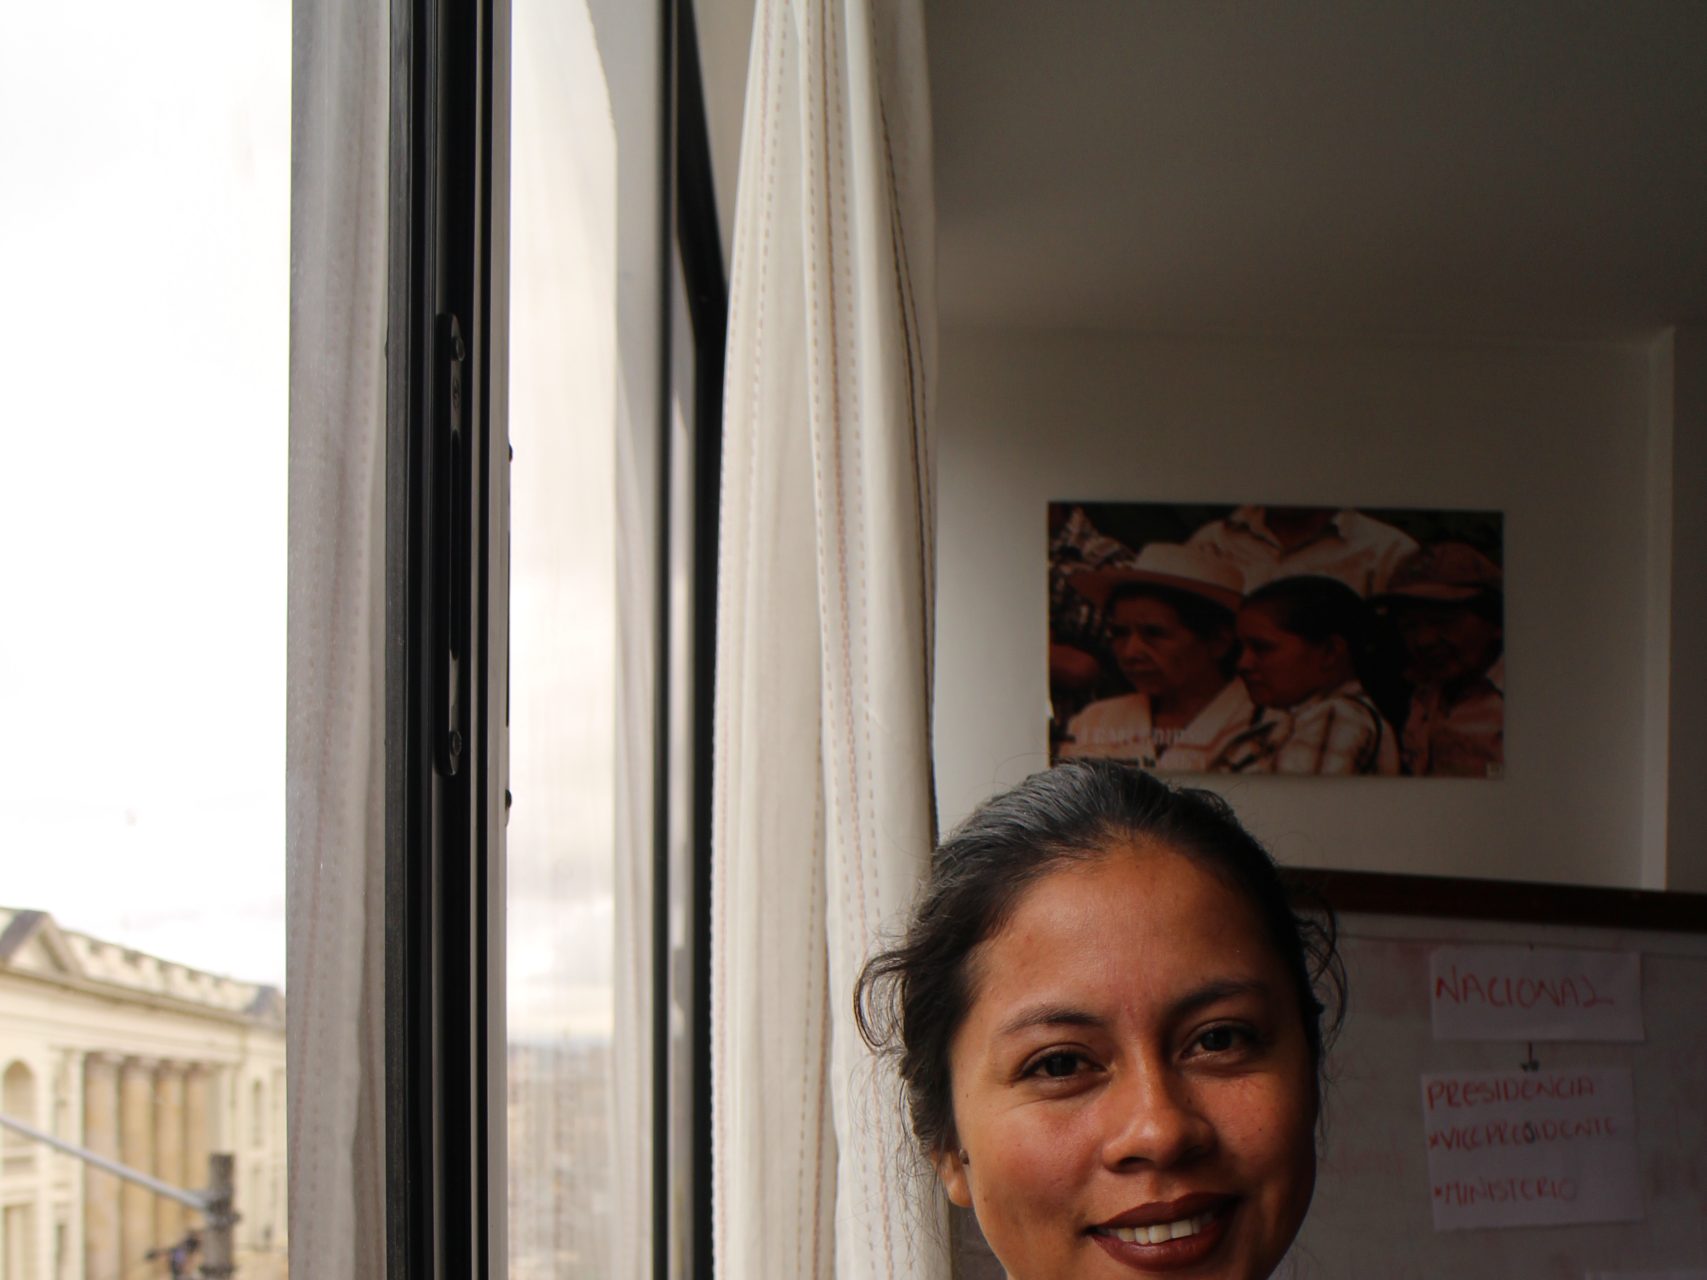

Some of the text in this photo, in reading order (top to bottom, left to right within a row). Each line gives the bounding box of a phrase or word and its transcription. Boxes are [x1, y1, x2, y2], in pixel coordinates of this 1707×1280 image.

[1434, 964, 1615, 1009] NACIONAL
[1426, 1074, 1595, 1111] PRESIDENCIA
[1445, 1176, 1578, 1207] MINISTERIO
